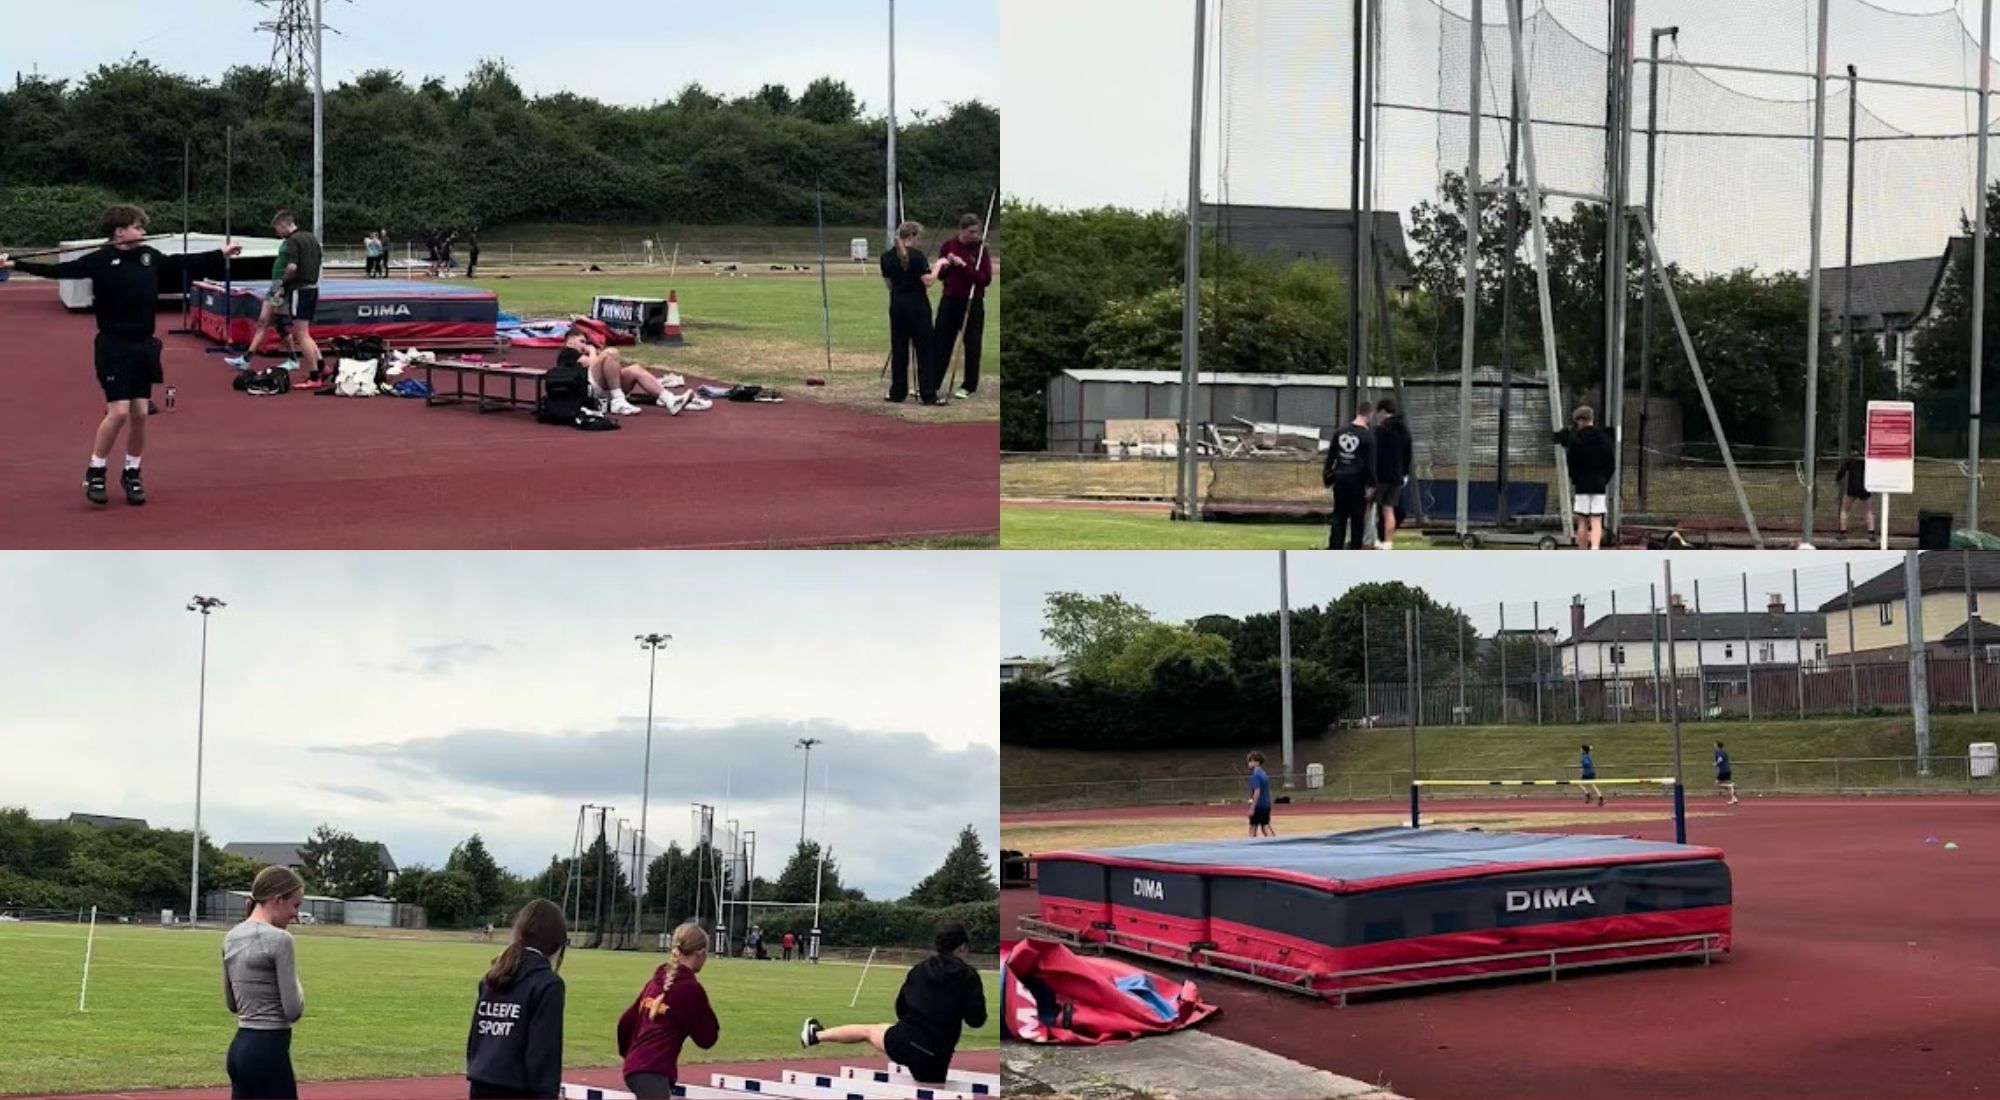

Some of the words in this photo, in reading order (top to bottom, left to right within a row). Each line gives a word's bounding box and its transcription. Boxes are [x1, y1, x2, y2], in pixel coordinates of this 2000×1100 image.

[358, 303, 411, 317] DIMA
[1133, 877, 1164, 901] DIMA
[1506, 886, 1596, 912] DIMA
[478, 1020, 515, 1036] SPORT
